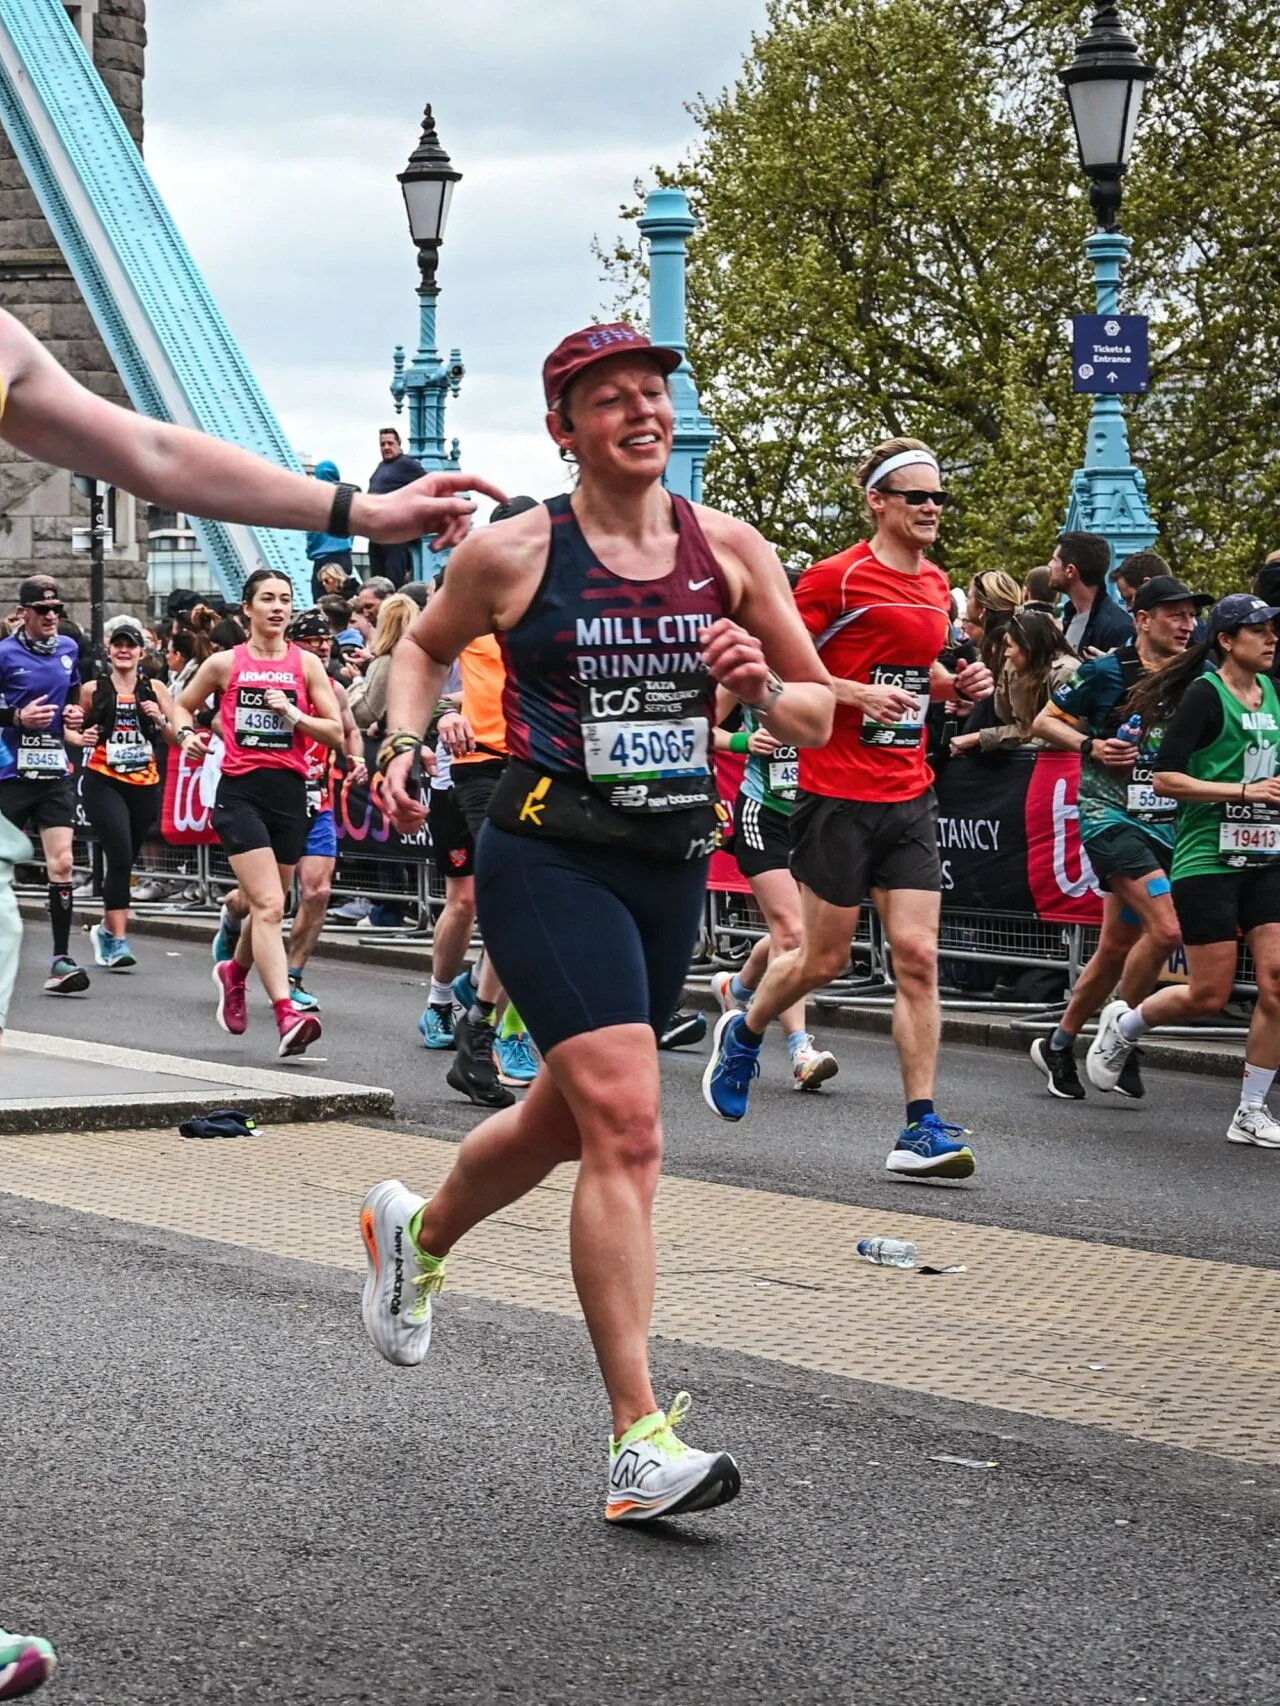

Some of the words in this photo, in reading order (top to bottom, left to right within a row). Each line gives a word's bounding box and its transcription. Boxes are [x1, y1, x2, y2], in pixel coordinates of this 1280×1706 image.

[1092, 345, 1123, 353] Tickets
[1124, 345, 1132, 354] &
[1092, 354, 1132, 363] Entrance
[576, 616, 653, 646] MILL
[577, 652, 710, 681] RUNNIN
[237, 671, 298, 684] ARMOREL
[644, 681, 677, 690] TATA
[874, 666, 904, 688] tcs
[241, 690, 263, 706] tcs
[589, 687, 642, 718] tcs
[21, 734, 40, 747] tcs
[609, 728, 696, 767] 45065
[26, 752, 59, 766] 63452
[773, 745, 798, 760] tcs
[648, 795, 669, 807] new
[669, 793, 710, 806] balance
[1225, 802, 1252, 819] tcs
[936, 817, 1000, 851] TANCY
[1232, 829, 1277, 848] 19413
[940, 859, 955, 890] S
[394, 1225, 404, 1259] new
[390, 1258, 404, 1316] balance
